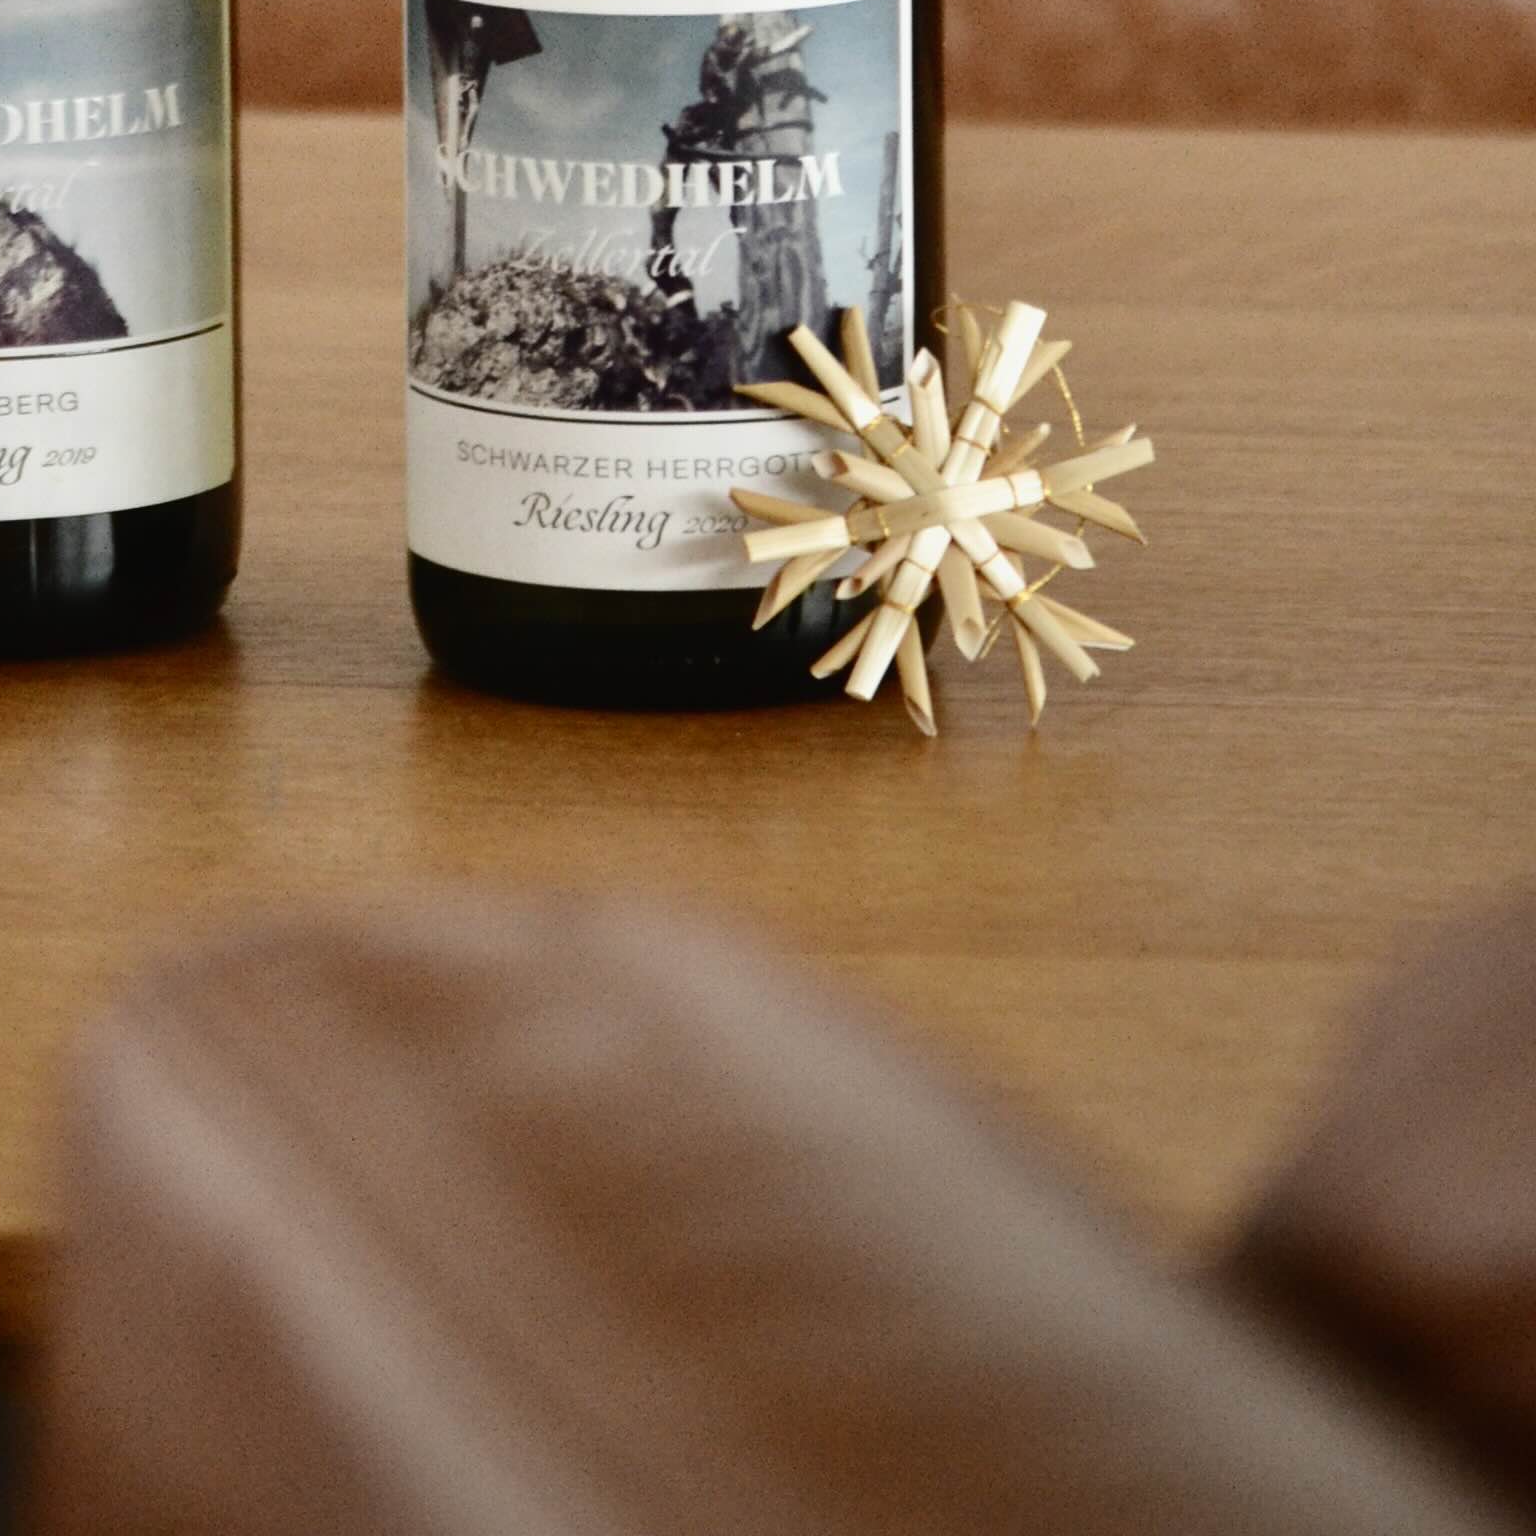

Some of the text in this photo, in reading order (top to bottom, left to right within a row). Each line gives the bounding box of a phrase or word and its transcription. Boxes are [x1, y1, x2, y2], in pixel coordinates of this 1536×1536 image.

[436, 144, 845, 209] SCHWEDHELM
[509, 227, 748, 278] Zellertal
[41, 446, 98, 468] 2019
[456, 439, 633, 479] SCHWARZER
[512, 491, 749, 551] Riesling 2020
